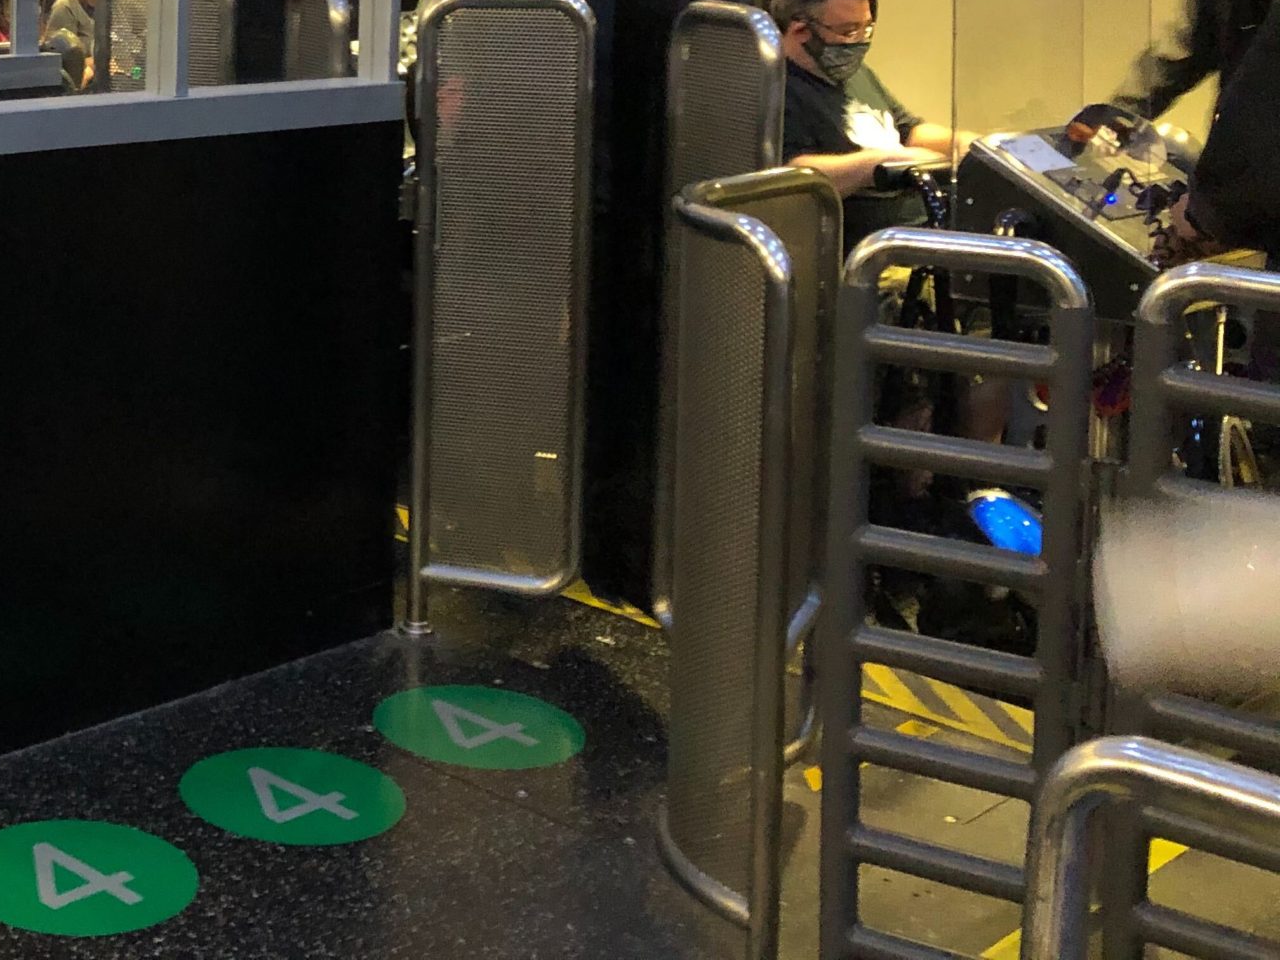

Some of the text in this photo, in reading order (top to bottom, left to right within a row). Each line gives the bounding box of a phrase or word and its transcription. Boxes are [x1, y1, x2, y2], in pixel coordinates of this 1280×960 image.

[432, 700, 539, 749] 4
[248, 767, 358, 823] 4
[33, 842, 143, 910] 4
